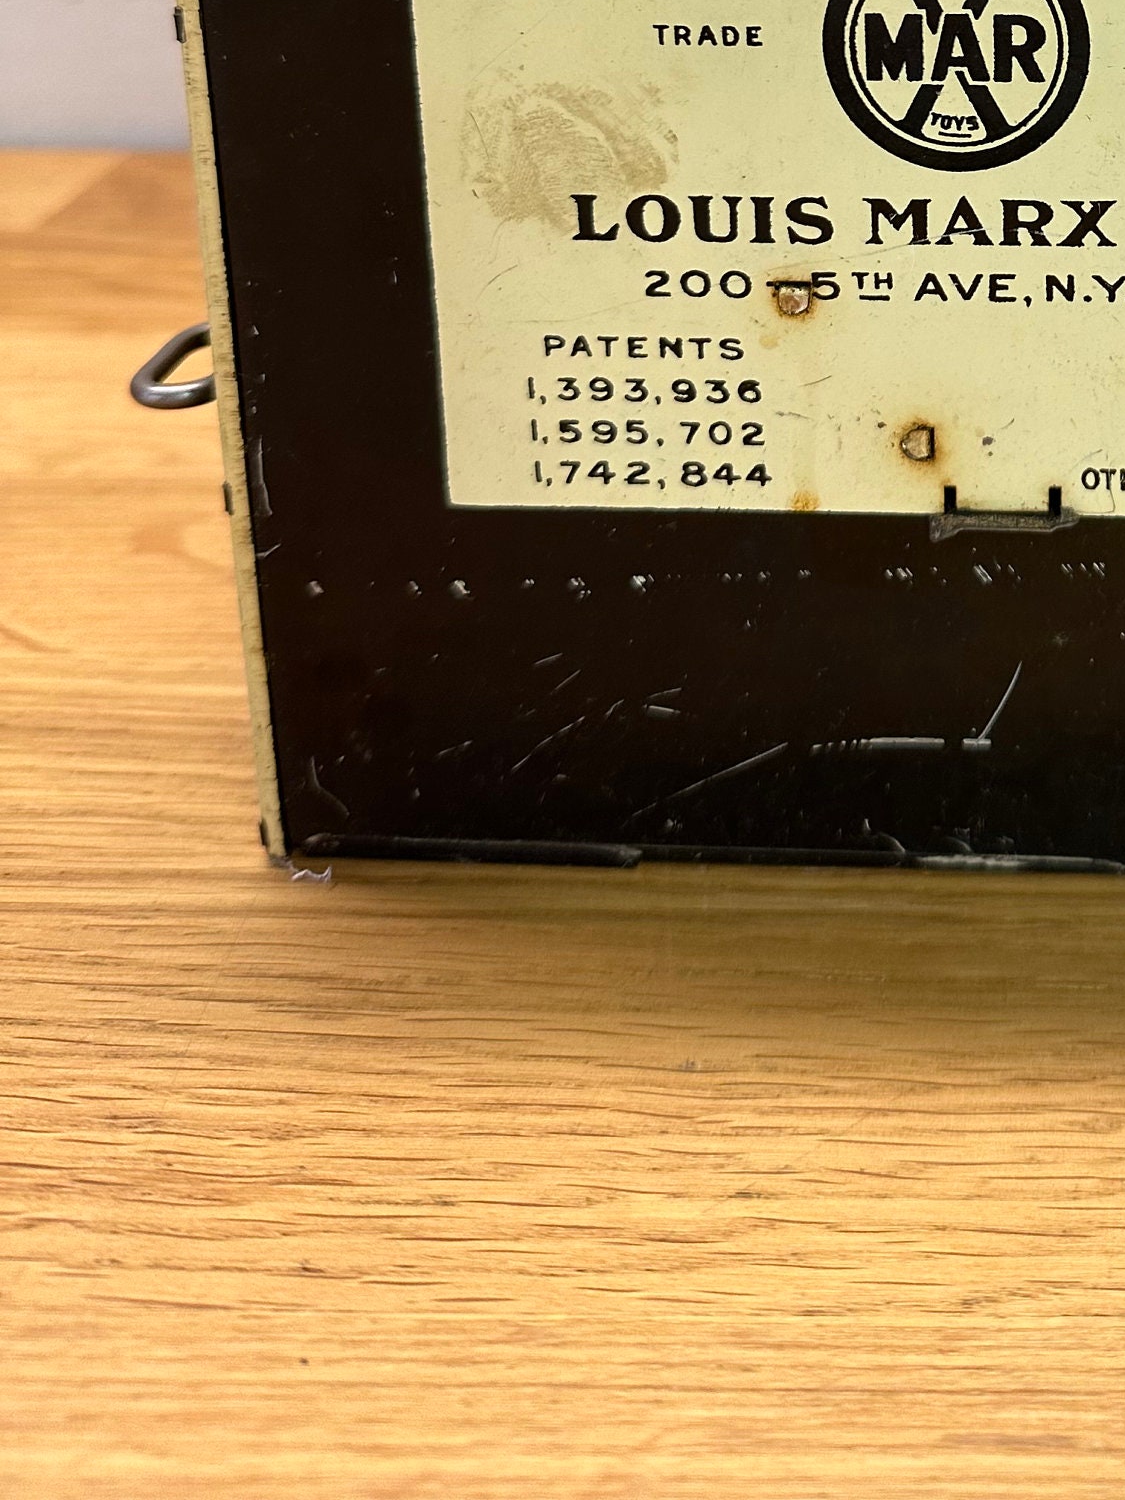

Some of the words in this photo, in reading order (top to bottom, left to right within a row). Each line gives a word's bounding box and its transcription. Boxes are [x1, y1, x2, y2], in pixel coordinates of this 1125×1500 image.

[652, 24, 763, 47] TRADE
[929, 111, 980, 132] TOYS
[569, 194, 834, 246] LOUIS
[862, 195, 1118, 248] MARX
[644, 269, 752, 299] 200
[543, 334, 744, 361] PATENTS
[527, 376, 762, 405] 1,393,936
[530, 418, 765, 447] 1,595,702
[534, 460, 772, 490] 1,742,844
